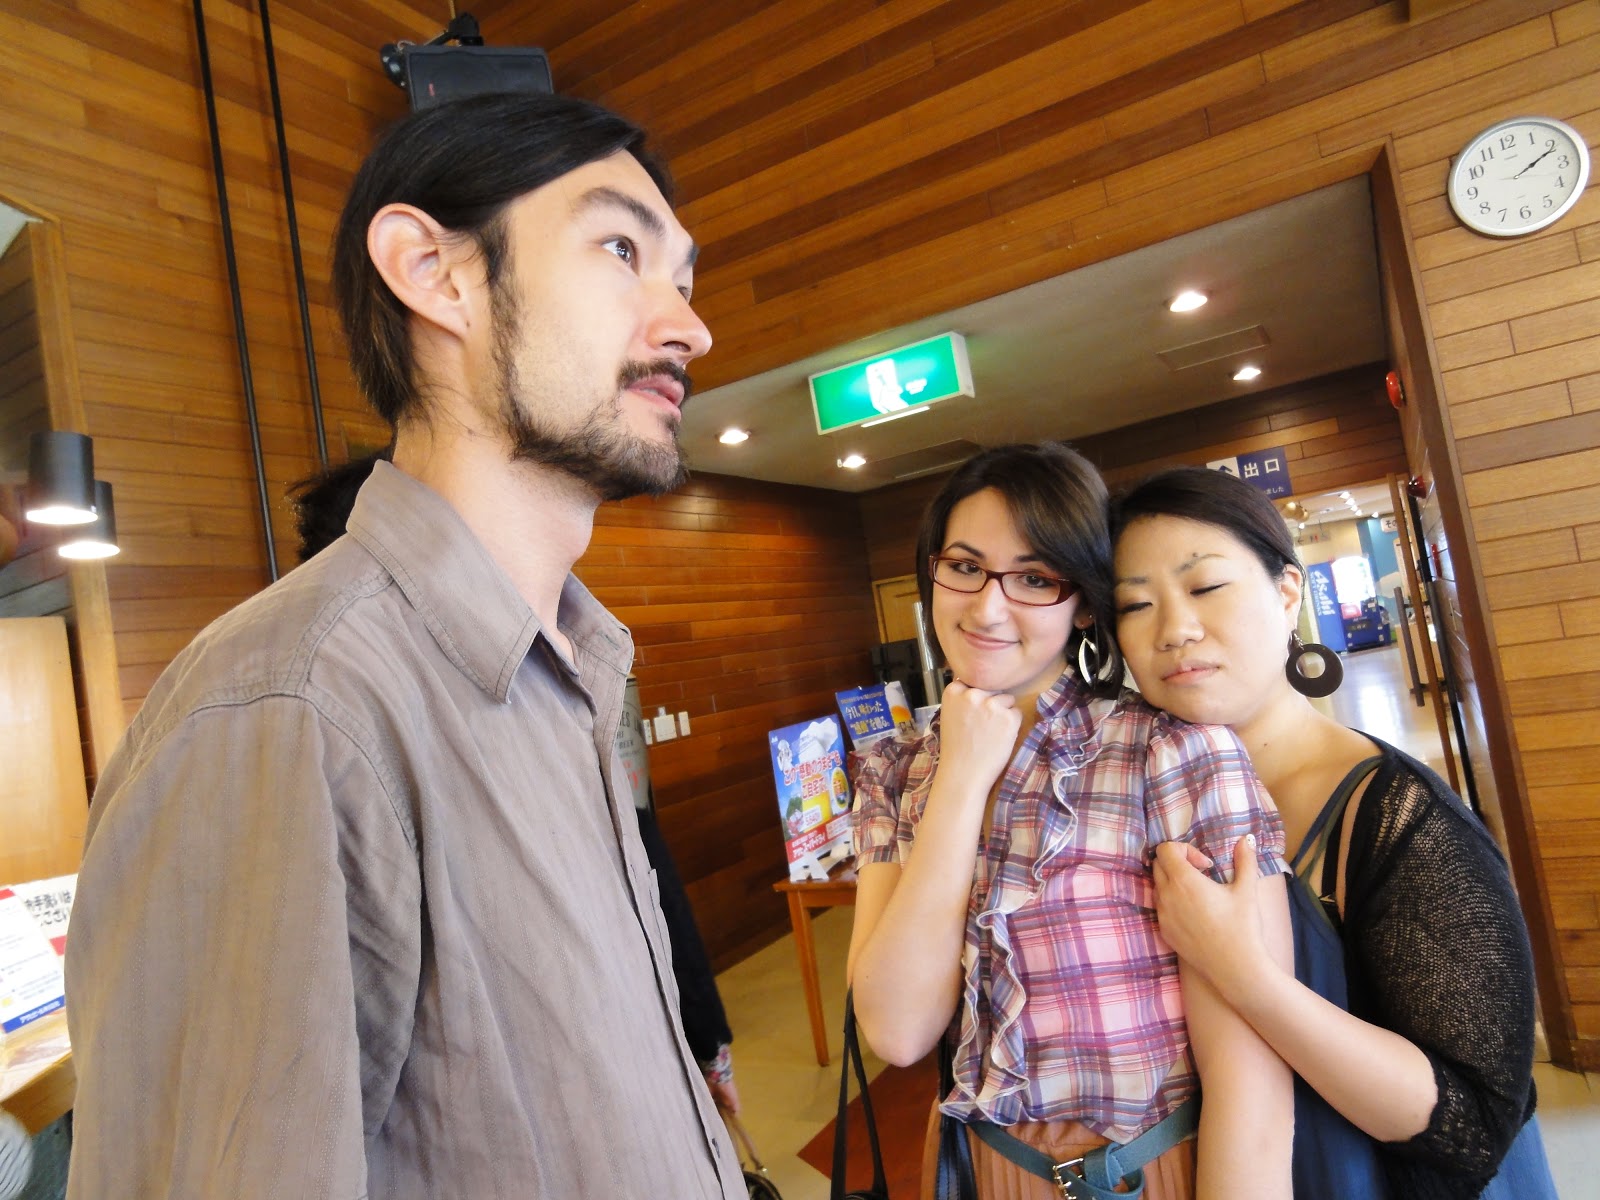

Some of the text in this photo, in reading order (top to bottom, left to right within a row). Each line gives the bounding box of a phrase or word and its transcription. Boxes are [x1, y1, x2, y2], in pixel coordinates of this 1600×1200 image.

[1499, 134, 1516, 151] 12
[1528, 132, 1536, 146] 1
[1545, 139, 1557, 153] 2
[1480, 146, 1495, 162] 11
[1557, 155, 1570, 169] 3
[1468, 164, 1485, 180] 10
[1554, 176, 1566, 189] 4
[1466, 186, 1479, 200] 9
[1479, 201, 1491, 215] 8
[1542, 194, 1553, 208] 5
[1497, 208, 1508, 222] 7
[1519, 205, 1532, 219] 6
[1243, 458, 1280, 478] 出口
[1314, 570, 1336, 616] Asahi
